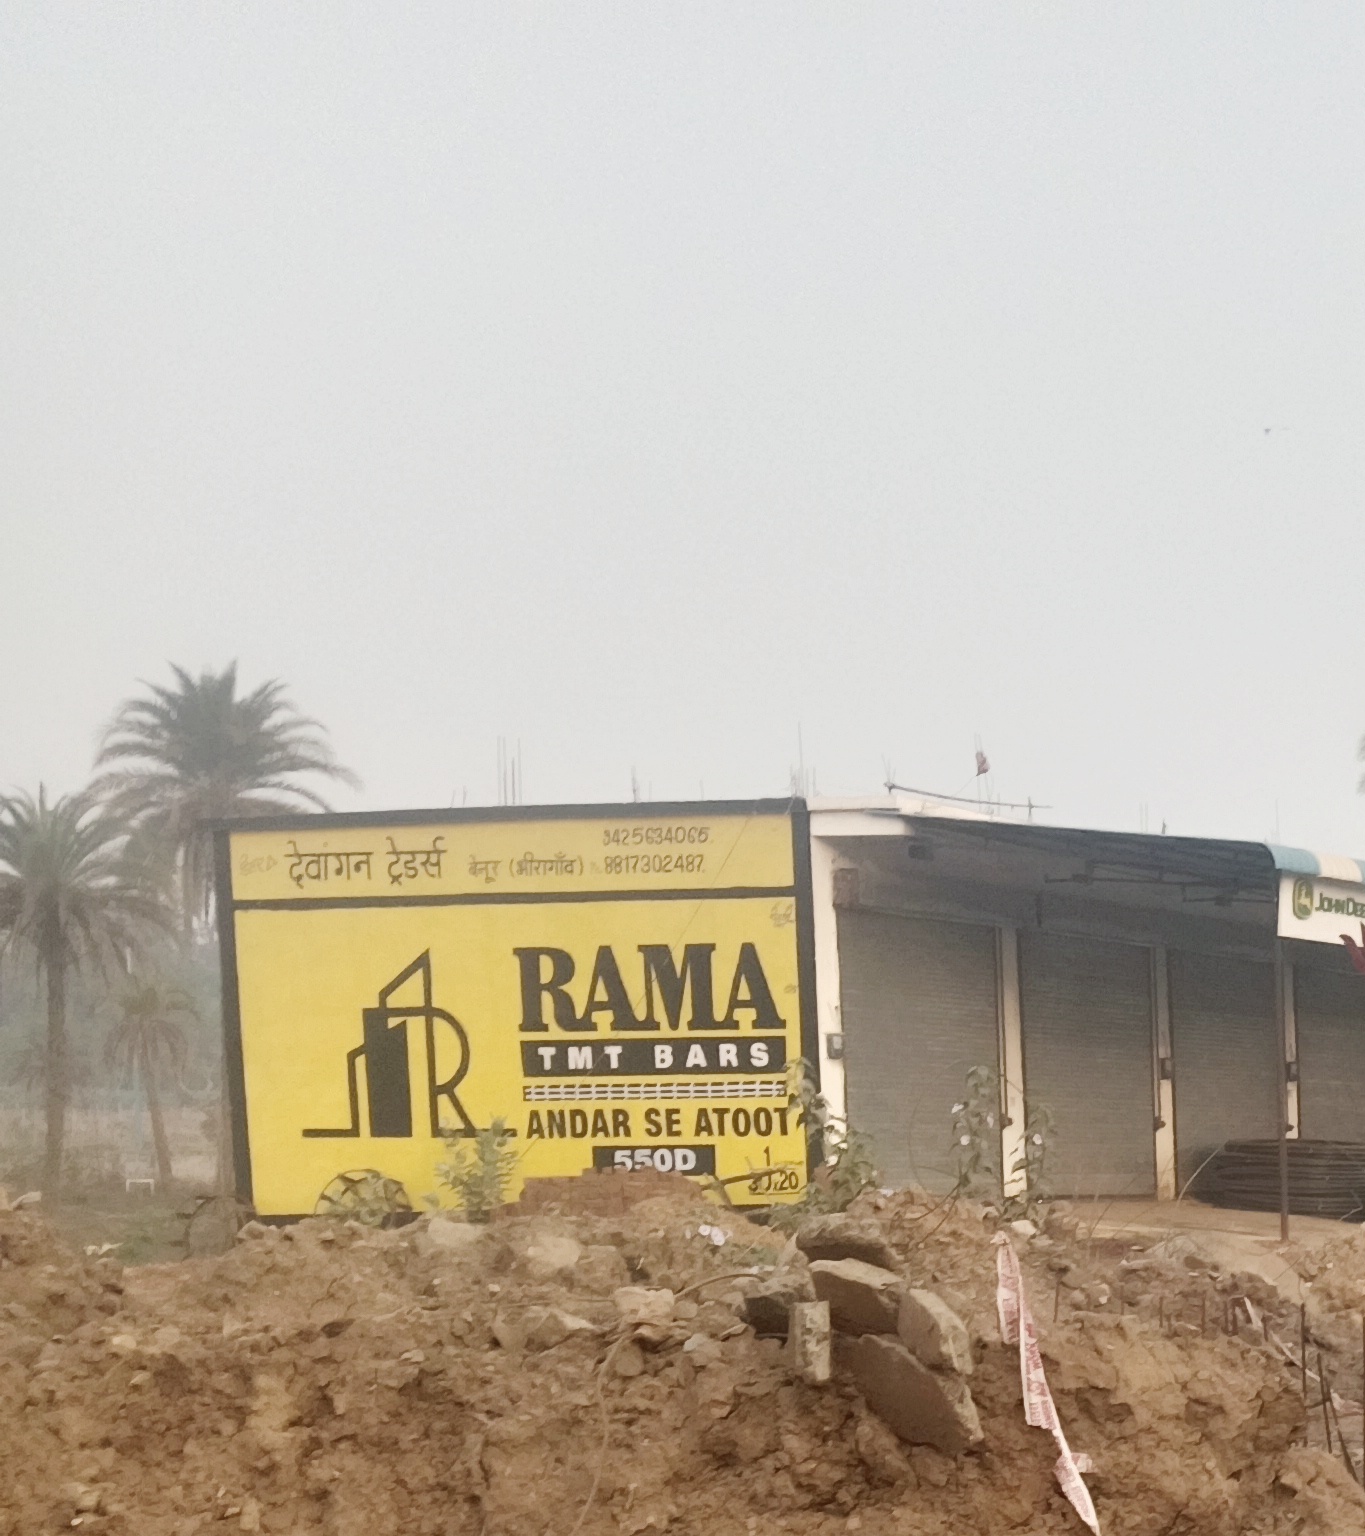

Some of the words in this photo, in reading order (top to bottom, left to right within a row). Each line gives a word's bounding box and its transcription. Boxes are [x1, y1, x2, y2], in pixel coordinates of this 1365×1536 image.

[512, 942, 787, 1032] RAMA
[537, 1045, 623, 1070] TMT
[653, 1042, 770, 1069] BARS
[526, 1109, 632, 1139] ANDAR
[644, 1107, 681, 1137] SE
[694, 1107, 789, 1137] ATOOT
[613, 1148, 697, 1172] 550D
